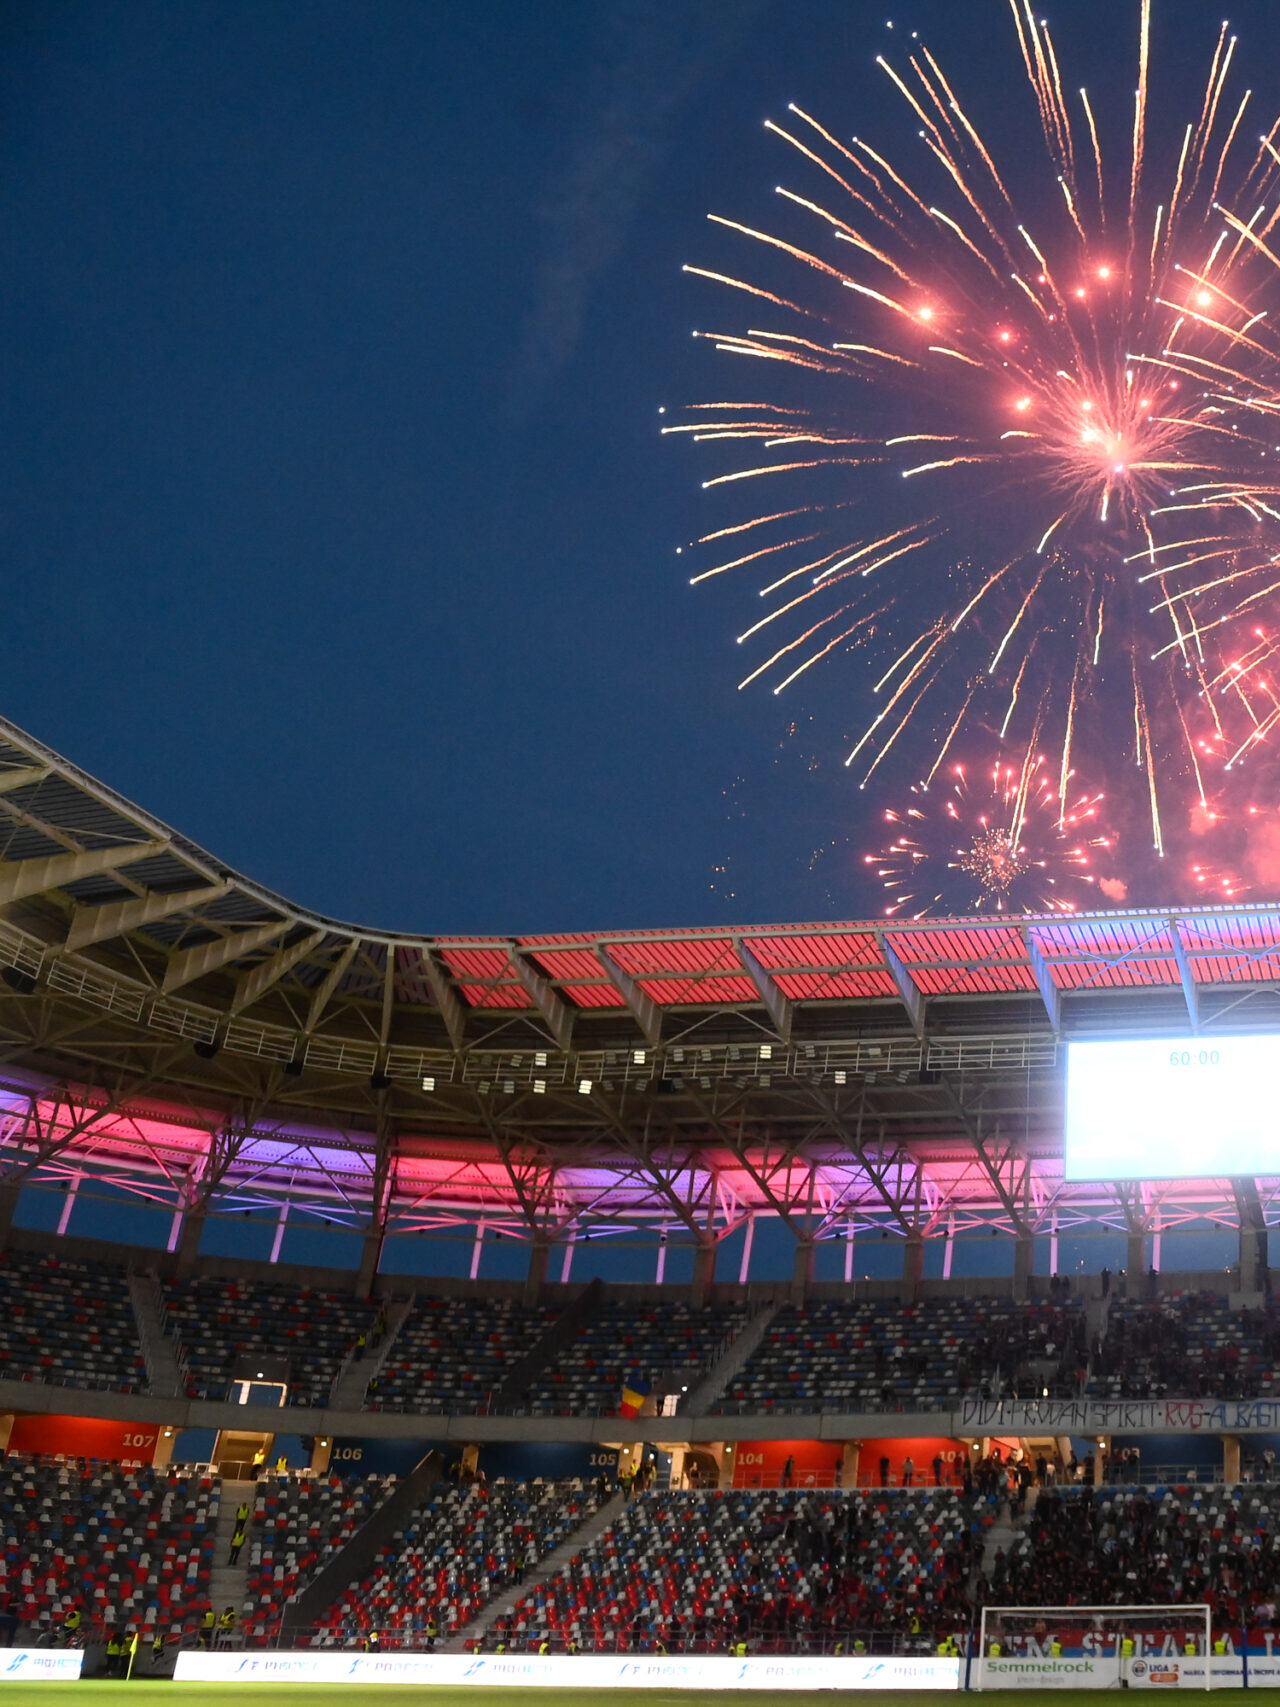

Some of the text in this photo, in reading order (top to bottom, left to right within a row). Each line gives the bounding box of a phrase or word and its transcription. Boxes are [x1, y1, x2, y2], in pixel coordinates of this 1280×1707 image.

[1169, 1050, 1220, 1066] 60:00
[122, 1433, 155, 1448] 107
[333, 1447, 363, 1461] 106
[588, 1453, 616, 1467] 105
[737, 1452, 764, 1466] 104
[987, 1661, 1095, 1673] Semmelrock
[1149, 1663, 1180, 1673] LIGA 2
